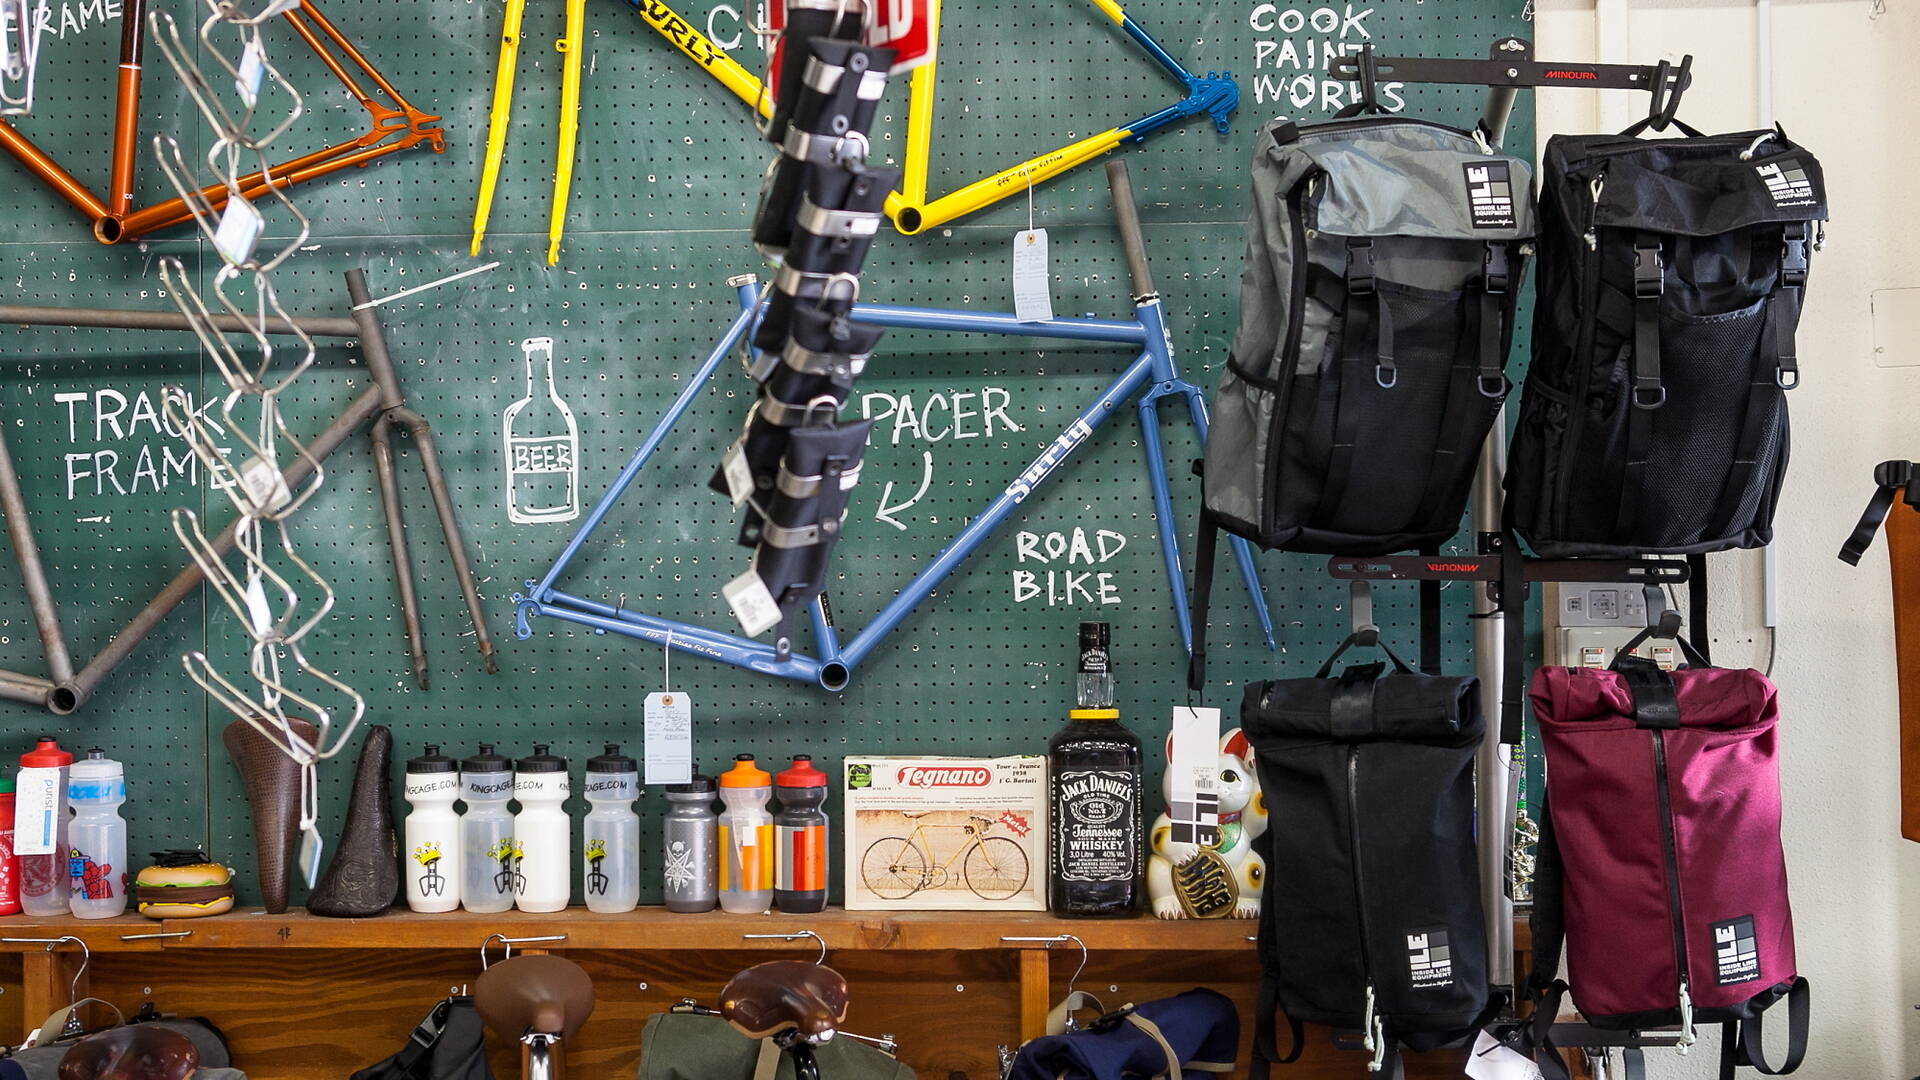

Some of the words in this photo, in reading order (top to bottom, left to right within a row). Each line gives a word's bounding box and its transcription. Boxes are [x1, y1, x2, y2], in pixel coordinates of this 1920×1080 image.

[7, 0, 122, 39] RAME
[645, 0, 725, 66] URLY
[1250, 4, 1374, 40] COOK
[1544, 71, 1598, 80] MINOURA
[54, 389, 226, 443] TRACK
[861, 387, 1020, 446] PACER
[64, 444, 237, 500] FRAME
[515, 443, 571, 469] BEER
[1005, 419, 1093, 504] Surly
[1016, 527, 1126, 565] ROAD
[1427, 562, 1479, 572] MINOURA
[1013, 569, 1122, 606] BIKE
[44, 779, 54, 809] purist
[406, 780, 458, 794] NGCAGE.COM
[470, 779, 514, 794] KINGCAGE
[1061, 779, 1089, 801] JACK
[1069, 840, 1125, 850] WHISKEY
[1072, 824, 1123, 837] Tennessee
